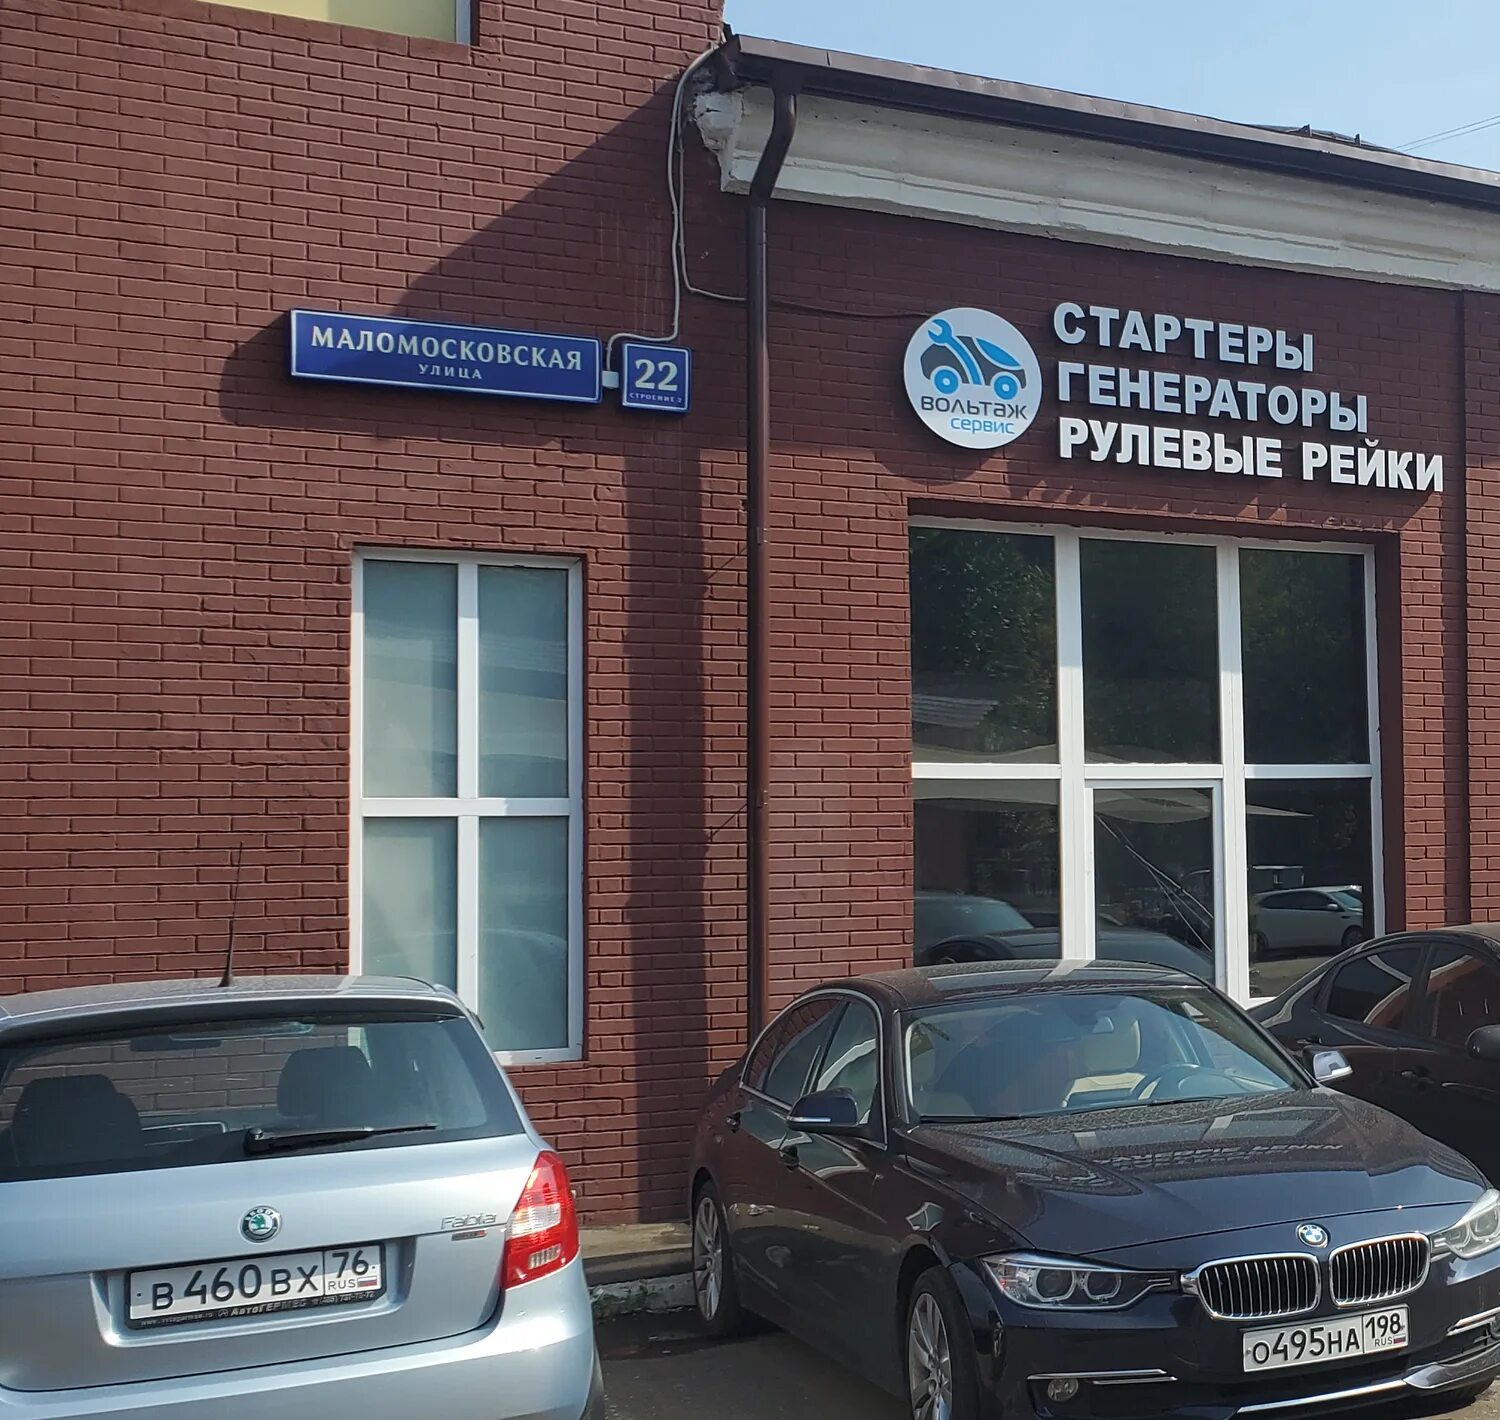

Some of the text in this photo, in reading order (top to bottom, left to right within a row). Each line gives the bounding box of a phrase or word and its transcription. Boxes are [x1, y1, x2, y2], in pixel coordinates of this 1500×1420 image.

[311, 325, 582, 371] МАЛОМОСКОВСКАЯ
[1053, 301, 1314, 372] СТАРТЕРЫ
[418, 363, 482, 380] УЛИЦА
[635, 358, 678, 392] 22
[629, 392, 675, 403] СТРОЕНИЕ
[1058, 362, 1368, 433] ГЕНЕРАТОРЫ
[950, 417, 1015, 434] сервис
[1058, 417, 1444, 493] РУЛЕВЫЕ РЕЙКИ
[152, 1250, 369, 1311] В460ВХ 76
[328, 1278, 356, 1291] RUS
[1253, 1313, 1401, 1364] О495НА 198
[1374, 1336, 1392, 1347] RUS
